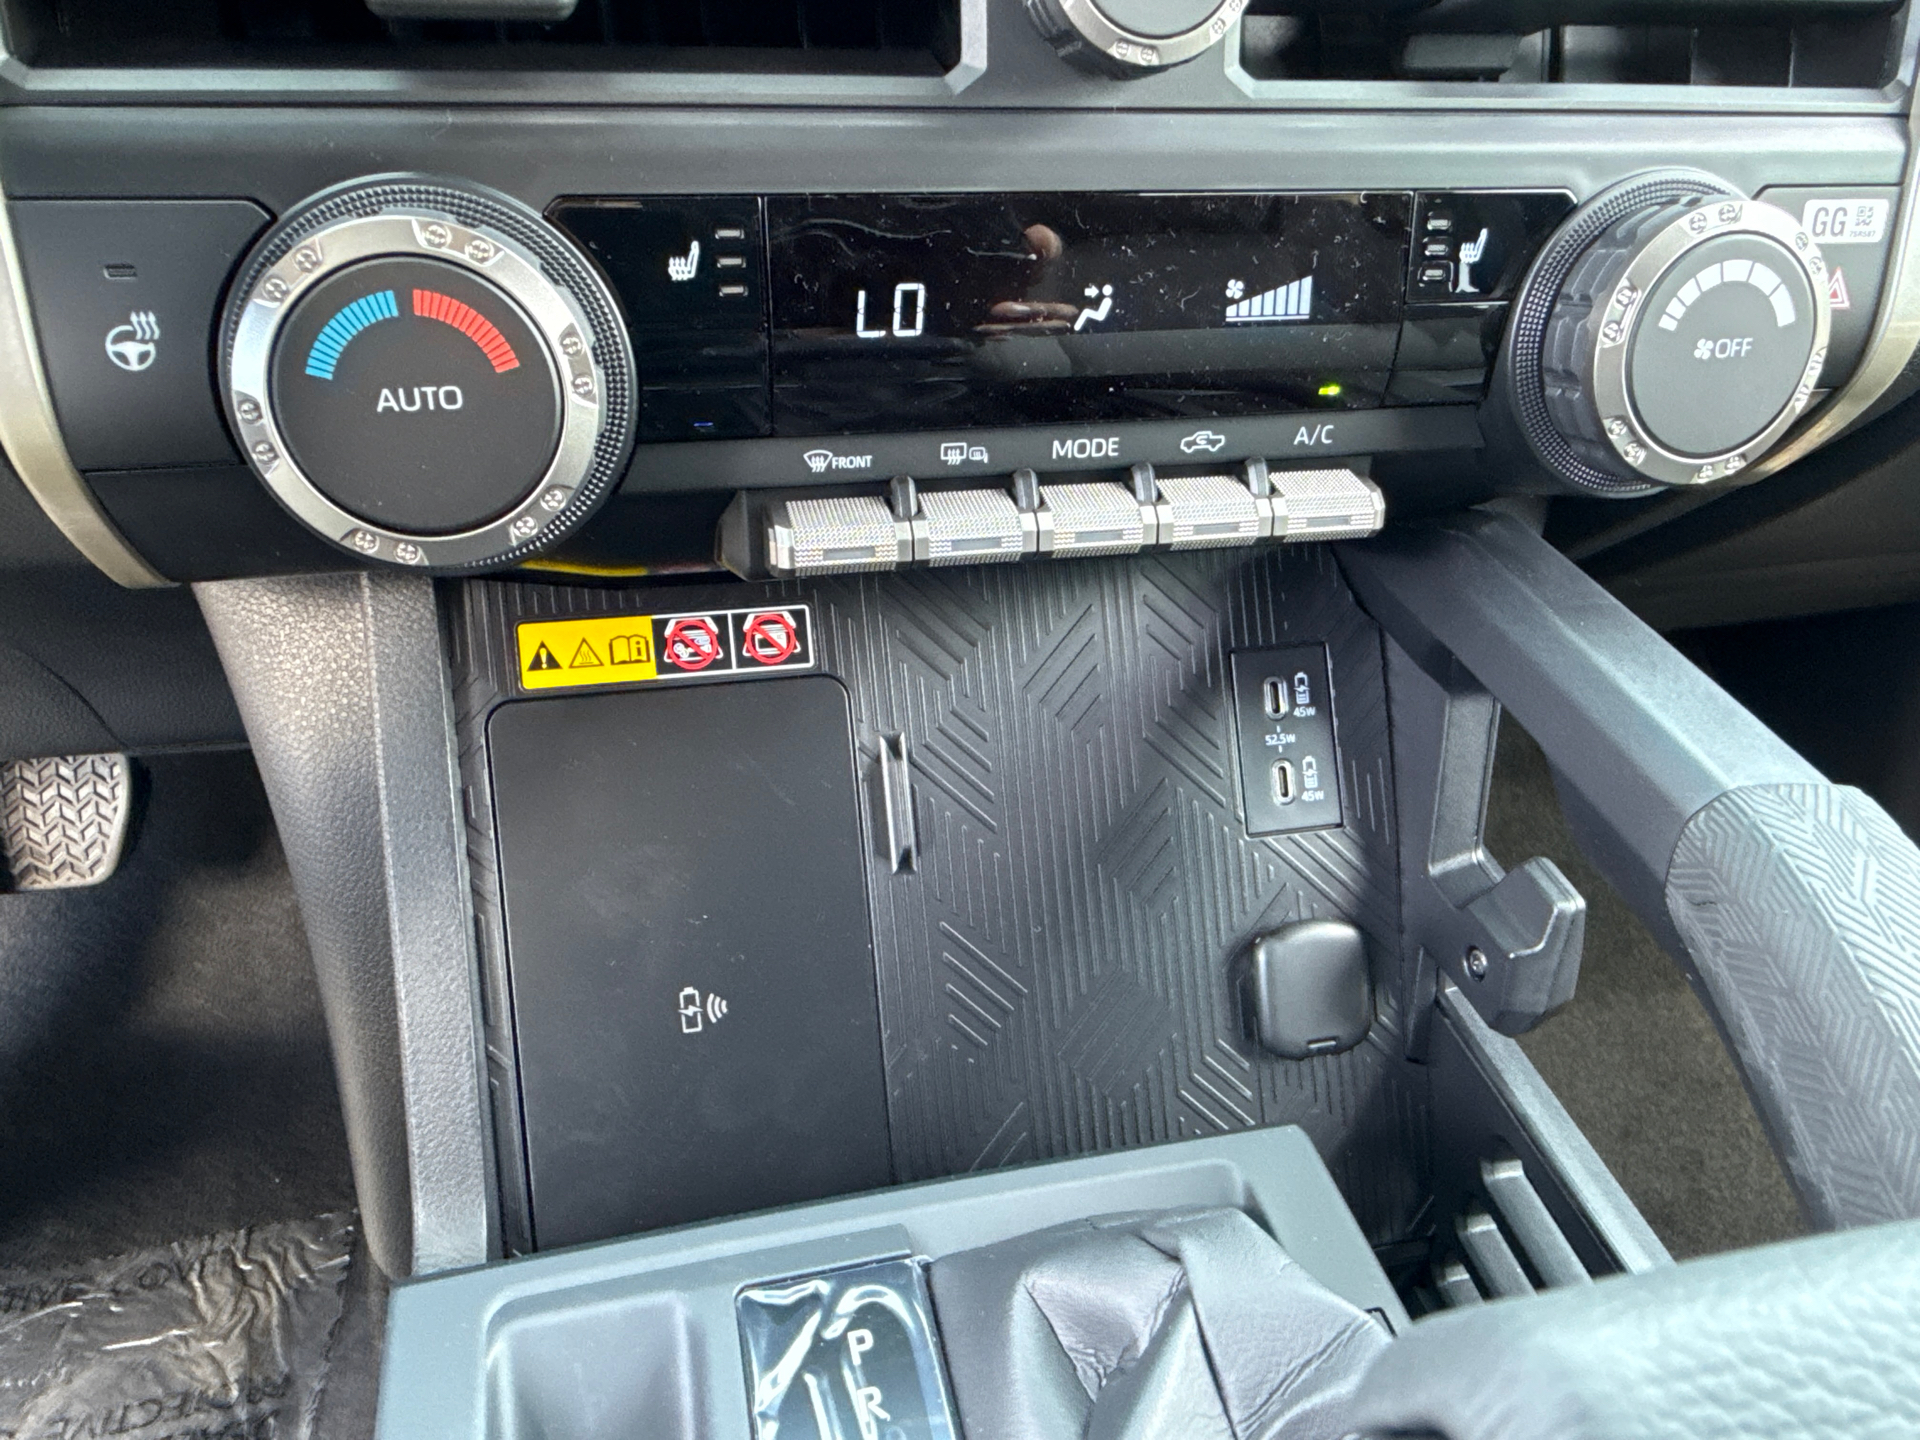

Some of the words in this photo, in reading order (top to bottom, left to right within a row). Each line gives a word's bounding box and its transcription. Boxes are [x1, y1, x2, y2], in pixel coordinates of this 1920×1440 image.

[1812, 206, 1848, 237] GG
[857, 282, 925, 338] LO
[1715, 337, 1753, 359] OFF
[376, 385, 463, 412] AUTO
[1293, 424, 1335, 446] A/C
[1052, 437, 1120, 460] MODE
[831, 455, 873, 470] FRONT
[1293, 706, 1316, 717] 45W
[1265, 733, 1296, 746] 52.5W
[1301, 790, 1325, 802] 45W
[847, 1328, 874, 1366] P
[856, 1386, 890, 1423] R
